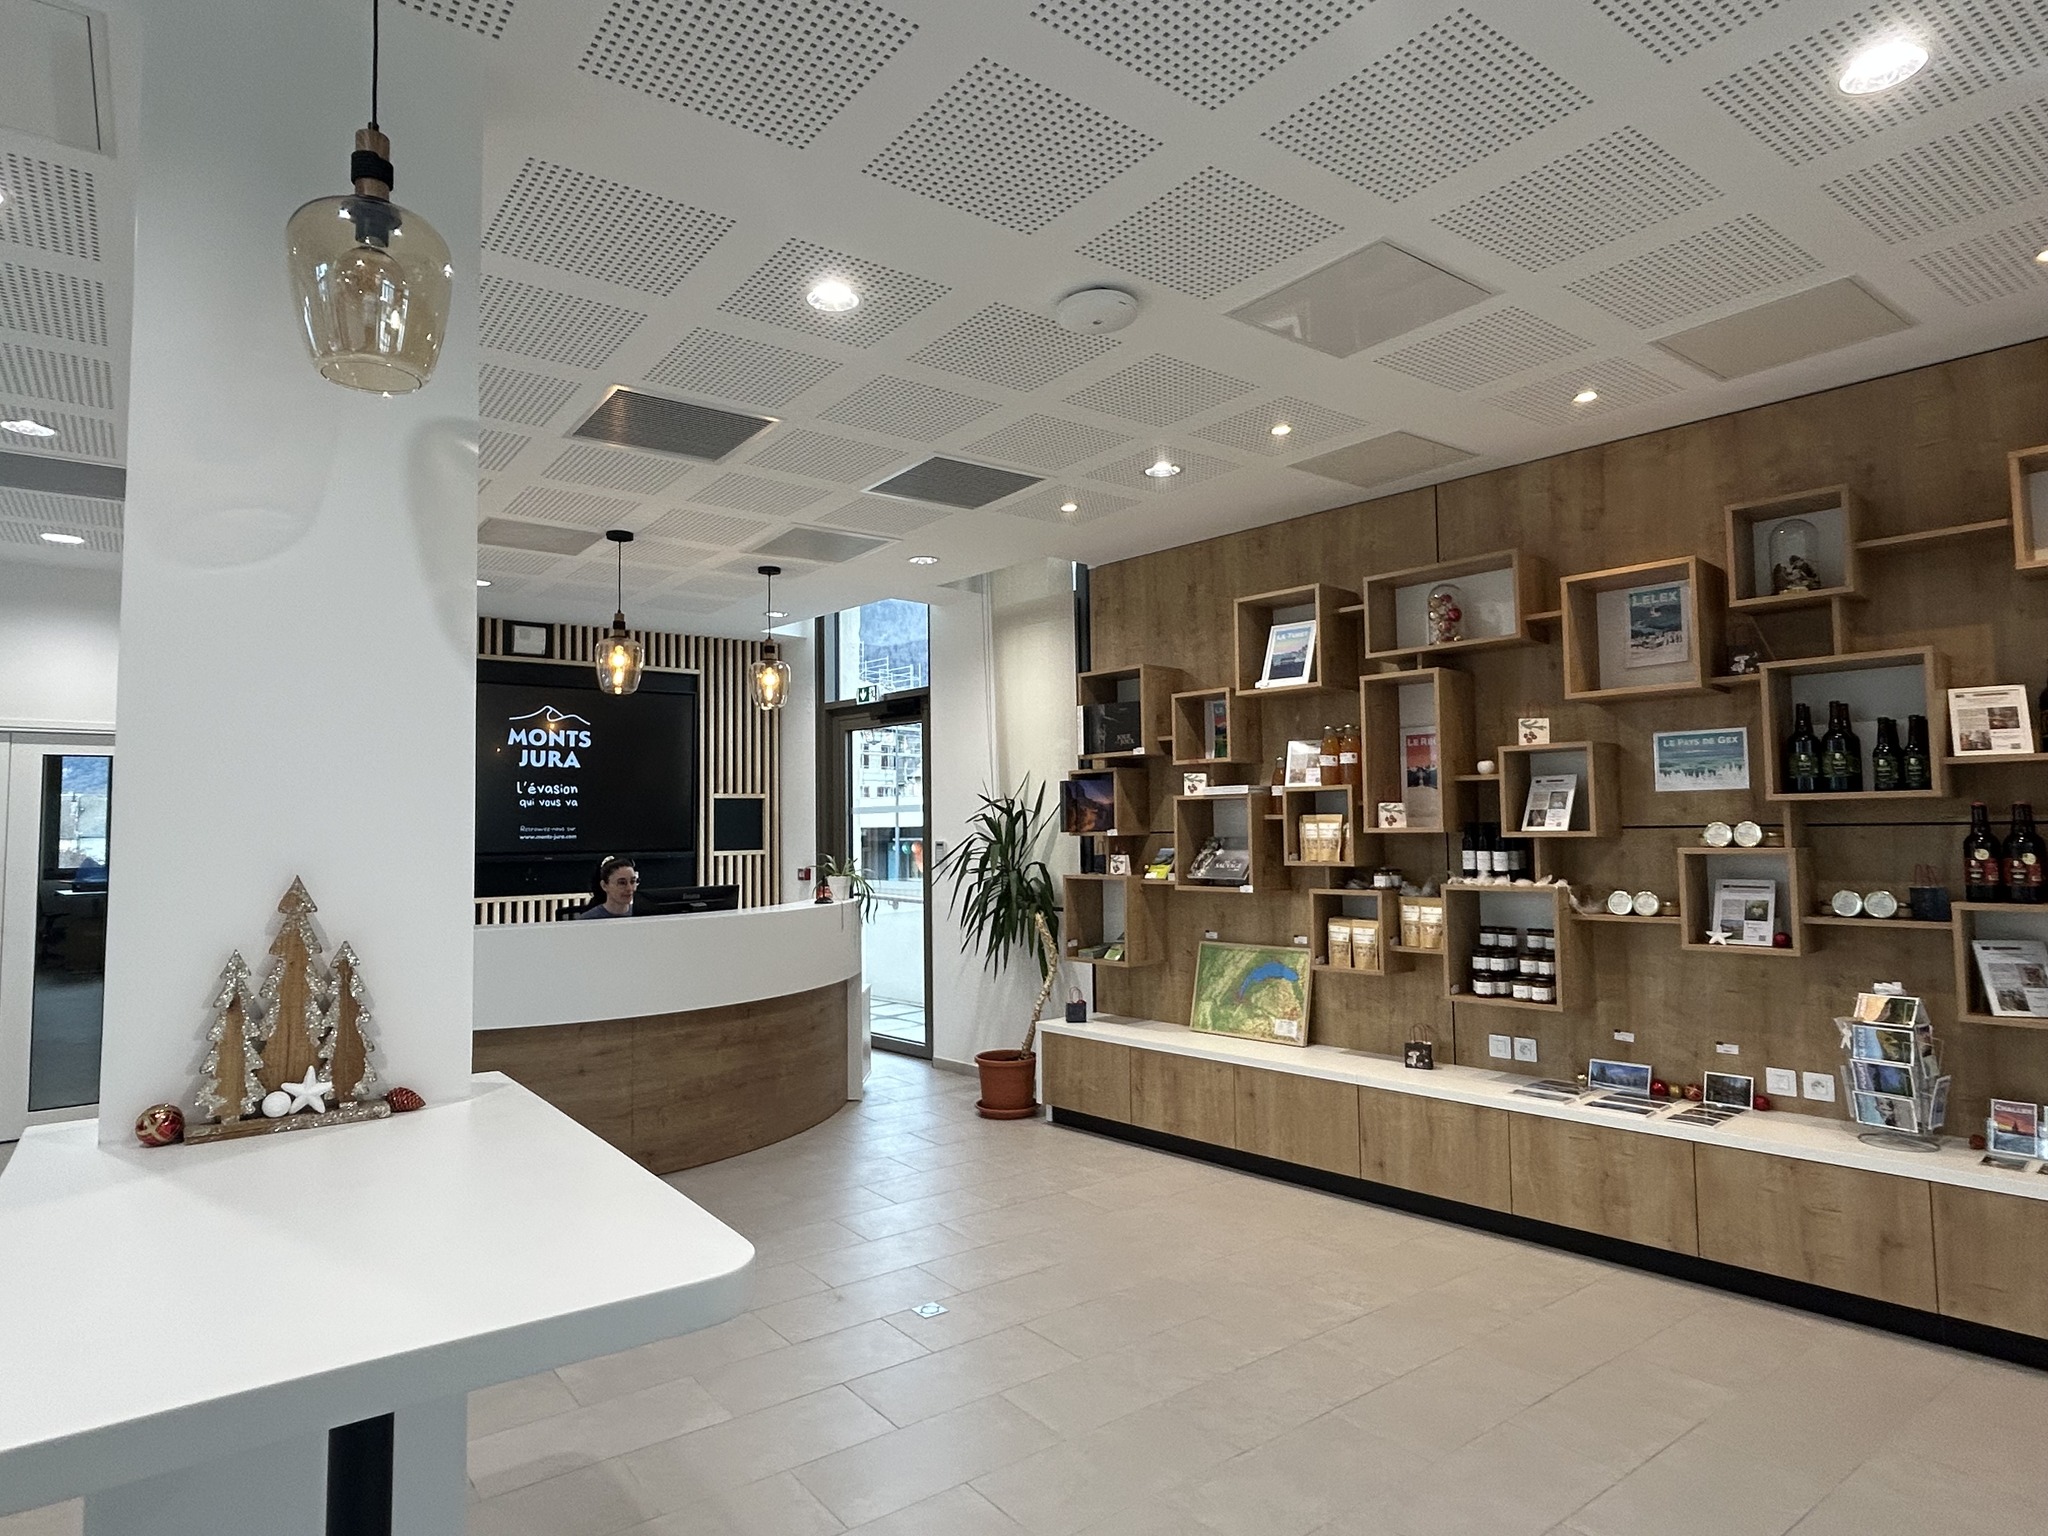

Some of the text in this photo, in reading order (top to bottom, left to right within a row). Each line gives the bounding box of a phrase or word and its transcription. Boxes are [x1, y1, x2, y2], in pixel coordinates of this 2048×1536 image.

[507, 728, 592, 748] MONTS
[1663, 739, 1676, 747] LE
[1718, 736, 1739, 744] GEX
[519, 750, 581, 768] JURA
[516, 781, 579, 795] l'évasion
[519, 798, 535, 808] qui
[539, 799, 562, 807] vous
